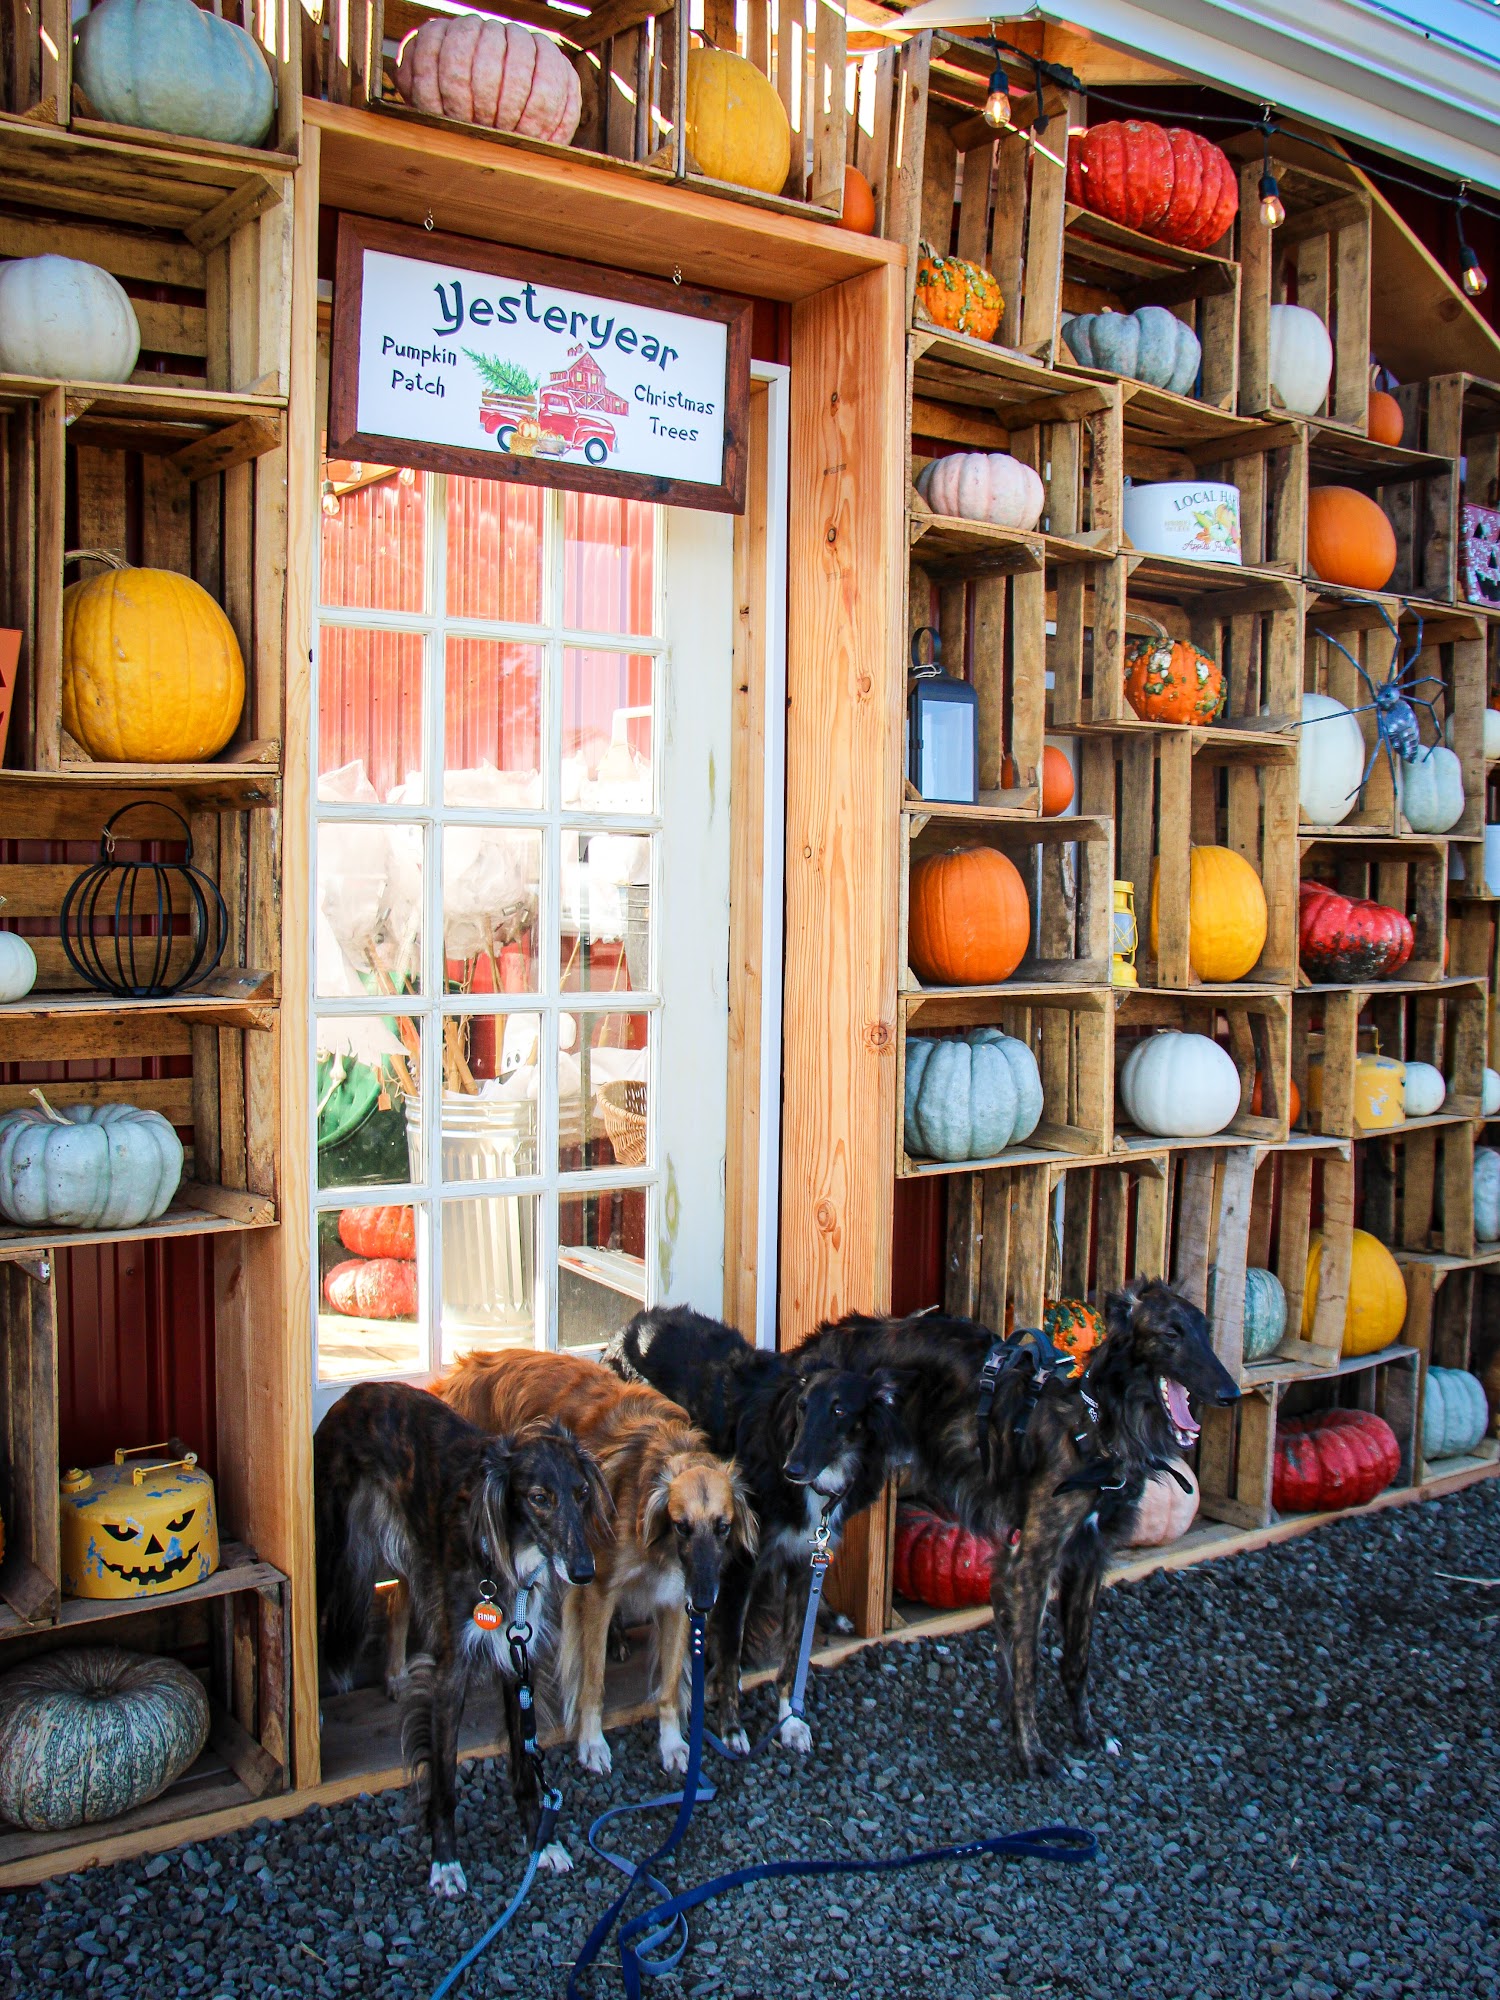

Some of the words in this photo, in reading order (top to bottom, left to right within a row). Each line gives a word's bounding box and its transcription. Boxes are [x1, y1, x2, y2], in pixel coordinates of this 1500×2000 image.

[433, 281, 679, 371] Yesteryear
[382, 335, 457, 367] Pumpkin
[391, 369, 445, 398] Patch
[634, 384, 715, 415] Christmas
[649, 416, 699, 442] Trees
[1174, 490, 1217, 511] LOCAL
